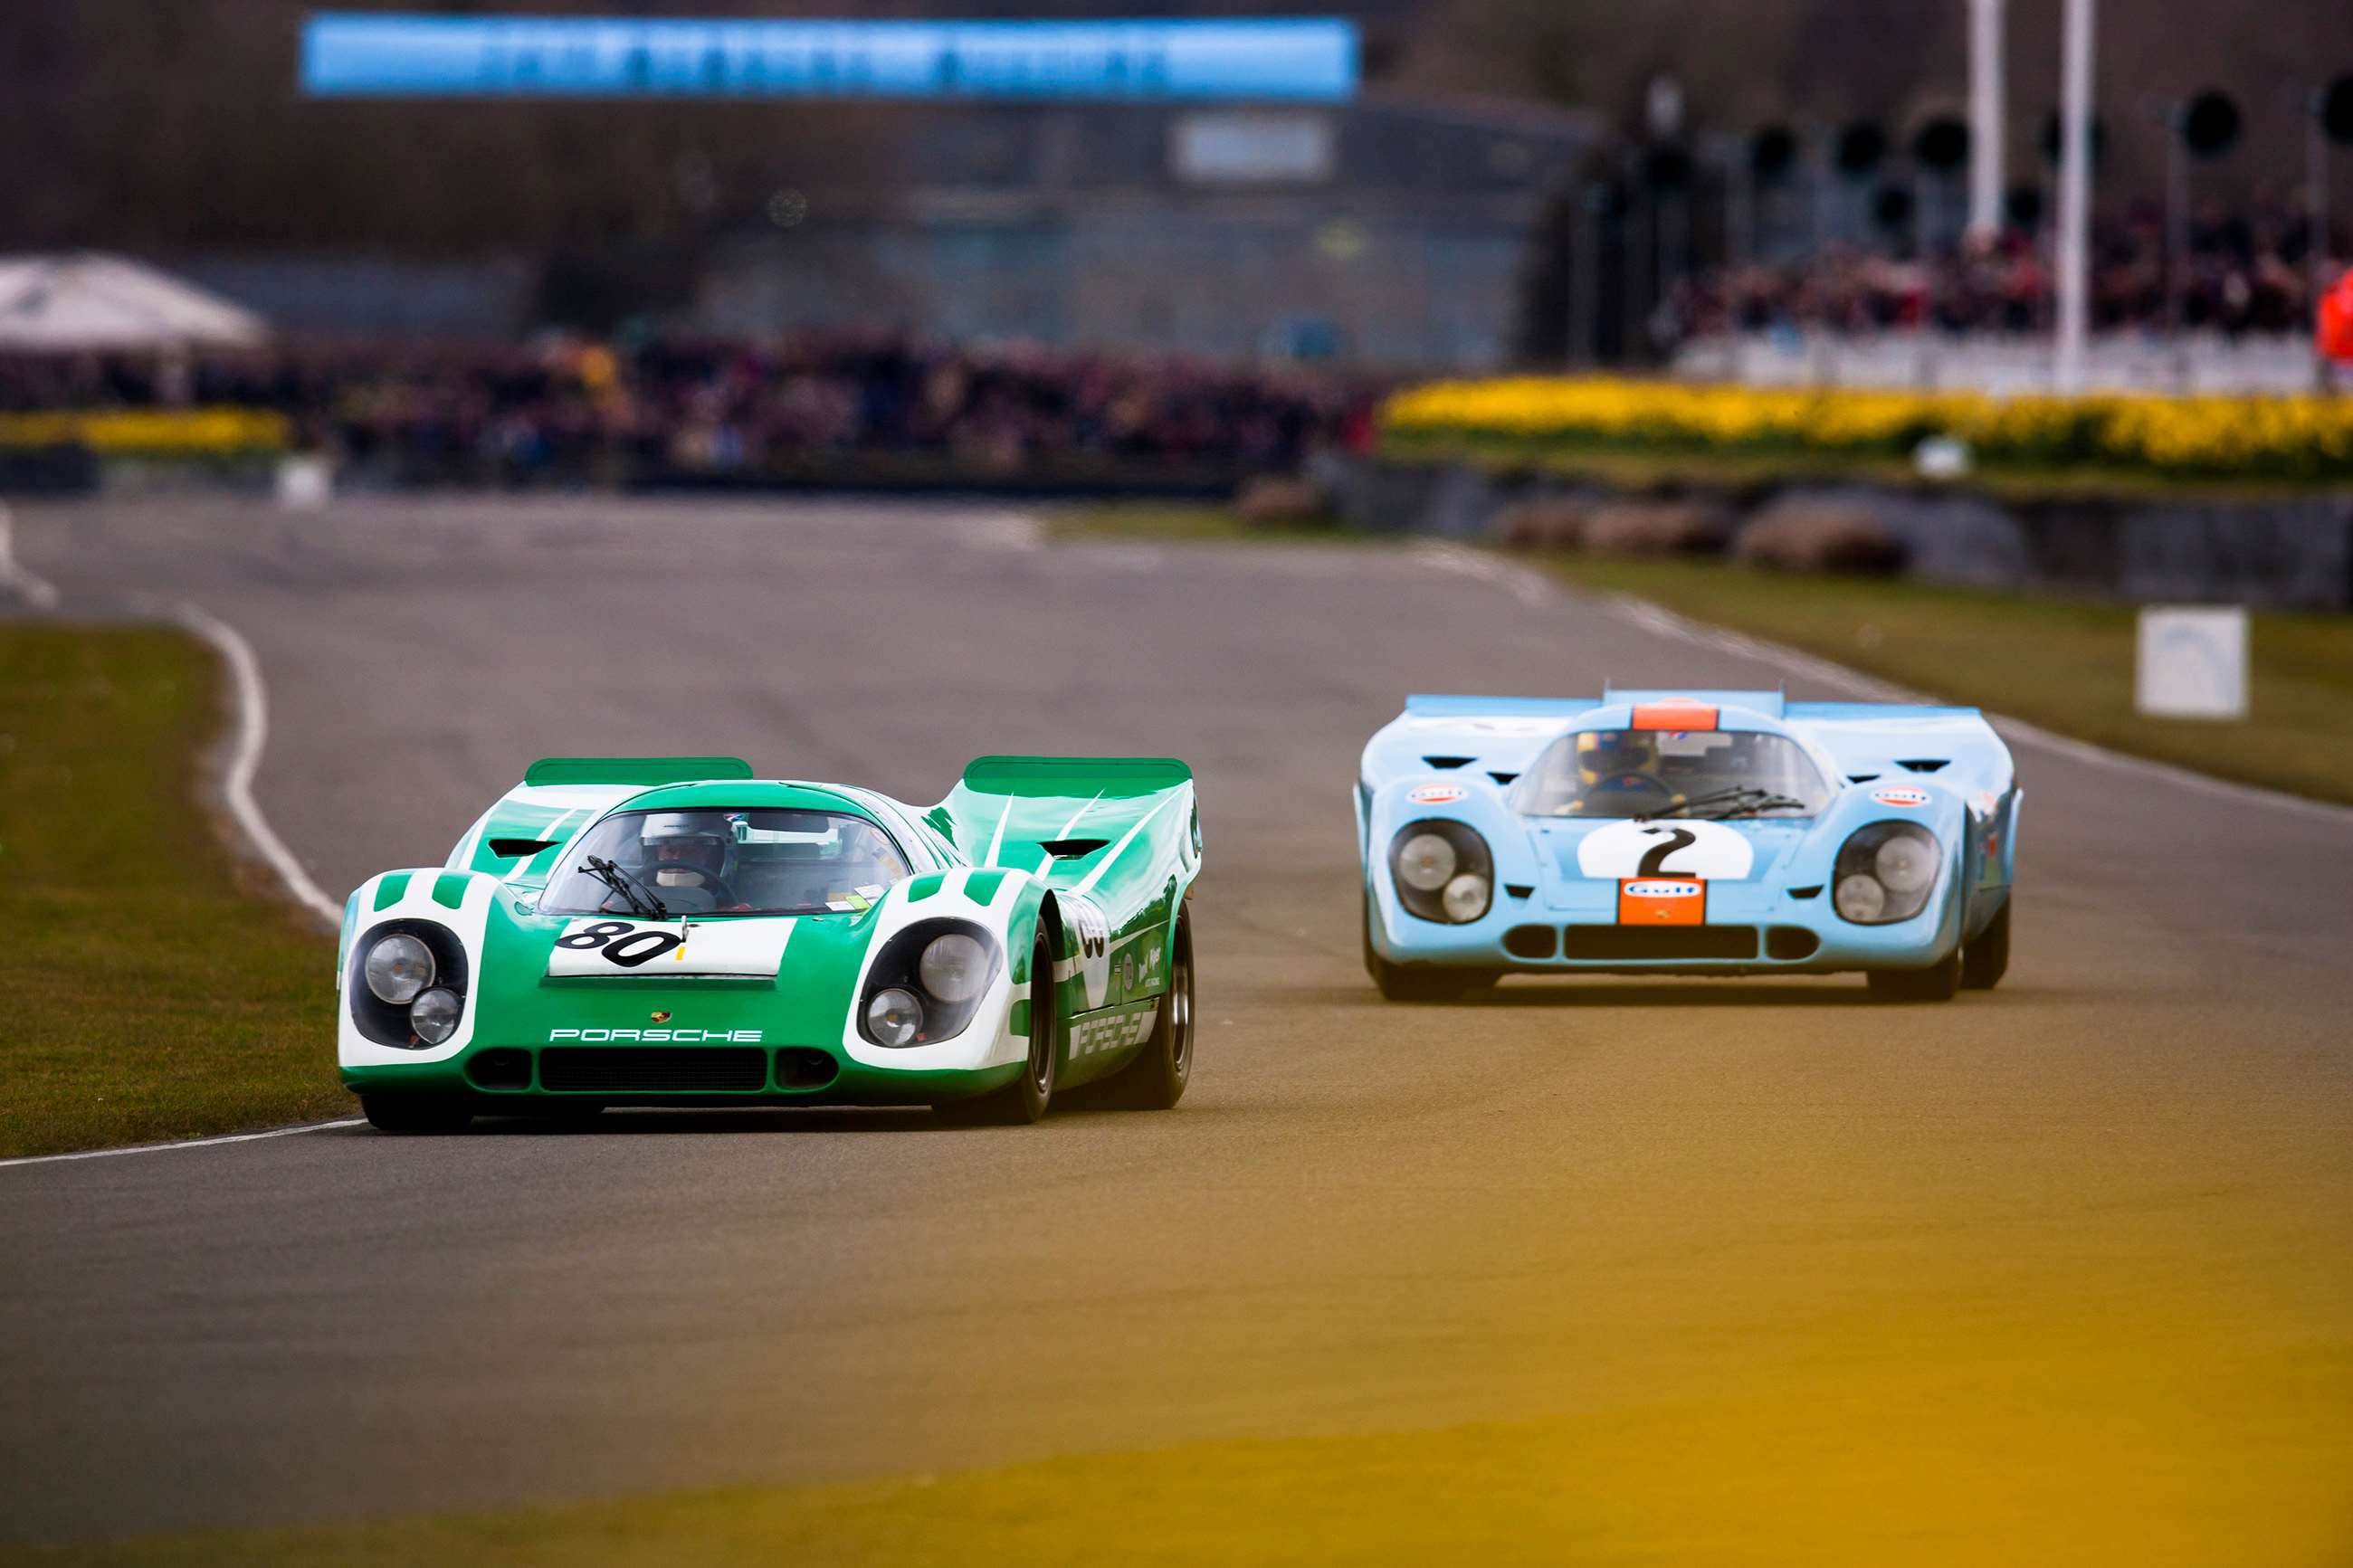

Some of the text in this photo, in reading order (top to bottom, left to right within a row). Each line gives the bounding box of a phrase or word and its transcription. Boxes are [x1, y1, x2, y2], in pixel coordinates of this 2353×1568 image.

[1636, 827, 1697, 879] 2
[1627, 882, 1697, 895] Gulf
[555, 921, 681, 967] 80
[549, 1029, 763, 1042] PORSCHE
